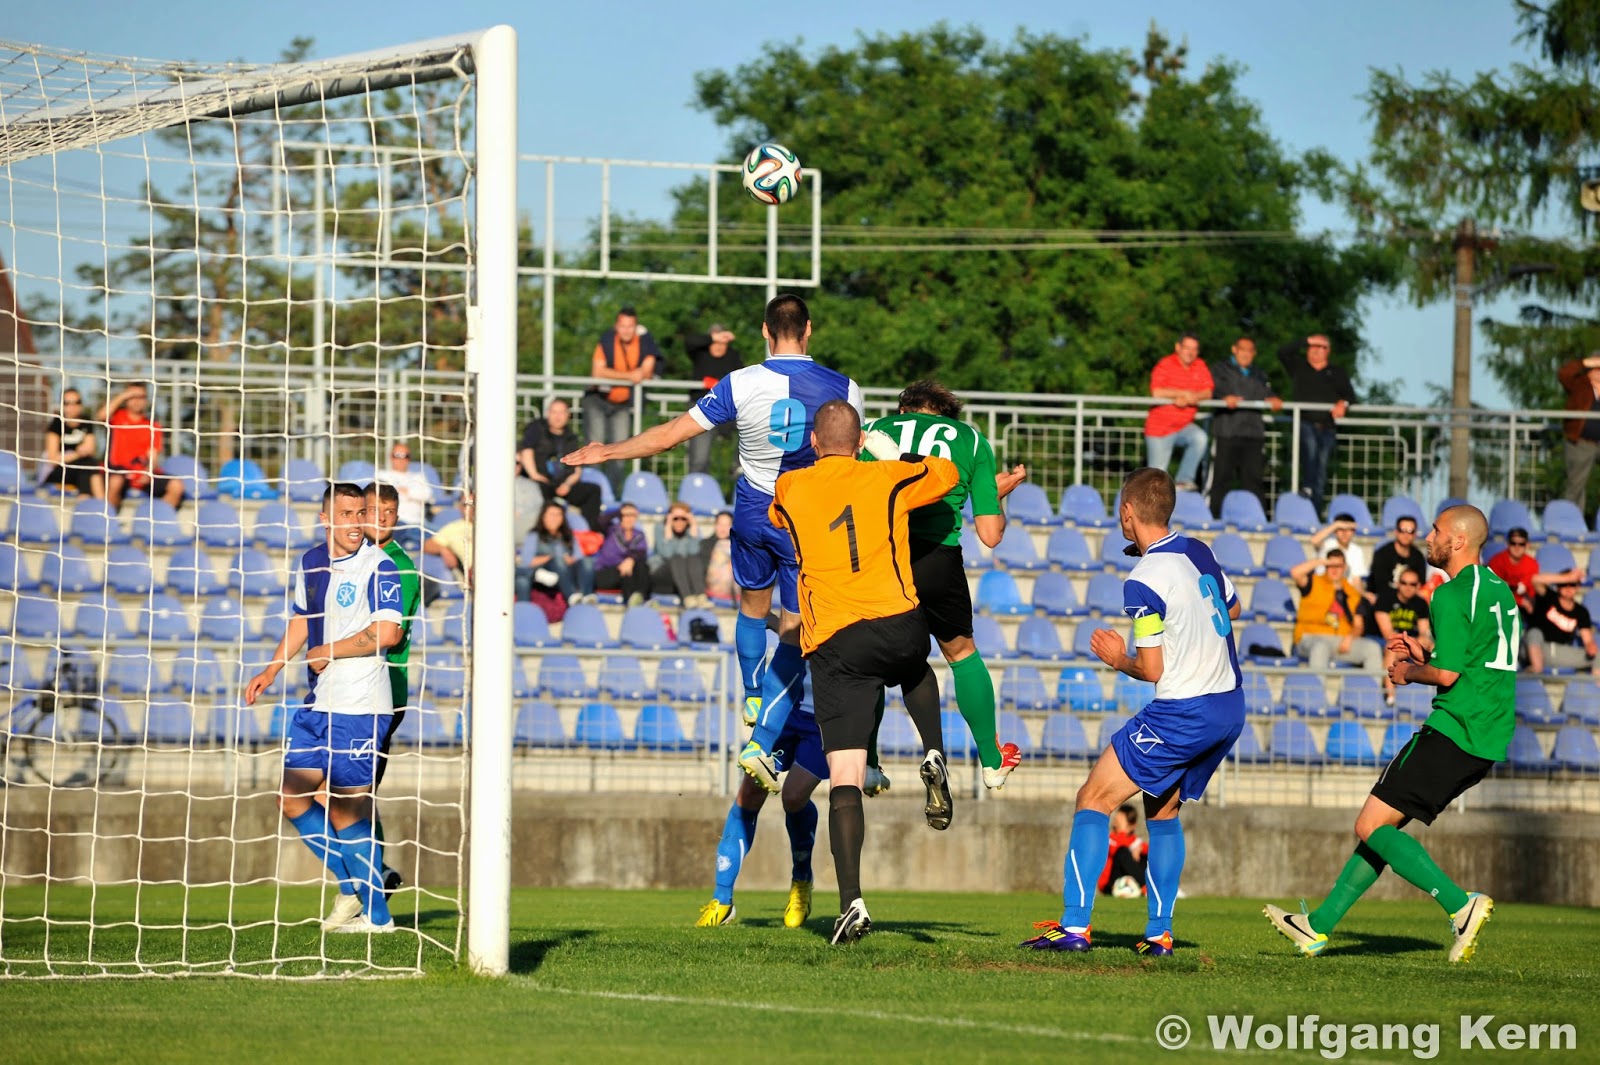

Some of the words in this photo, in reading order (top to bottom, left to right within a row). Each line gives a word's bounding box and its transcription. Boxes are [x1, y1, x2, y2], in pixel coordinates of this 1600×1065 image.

[768, 398, 806, 452] 9
[893, 419, 958, 461] 16
[829, 504, 860, 573] 1
[1198, 573, 1231, 637] 3
[1485, 601, 1520, 671] 11
